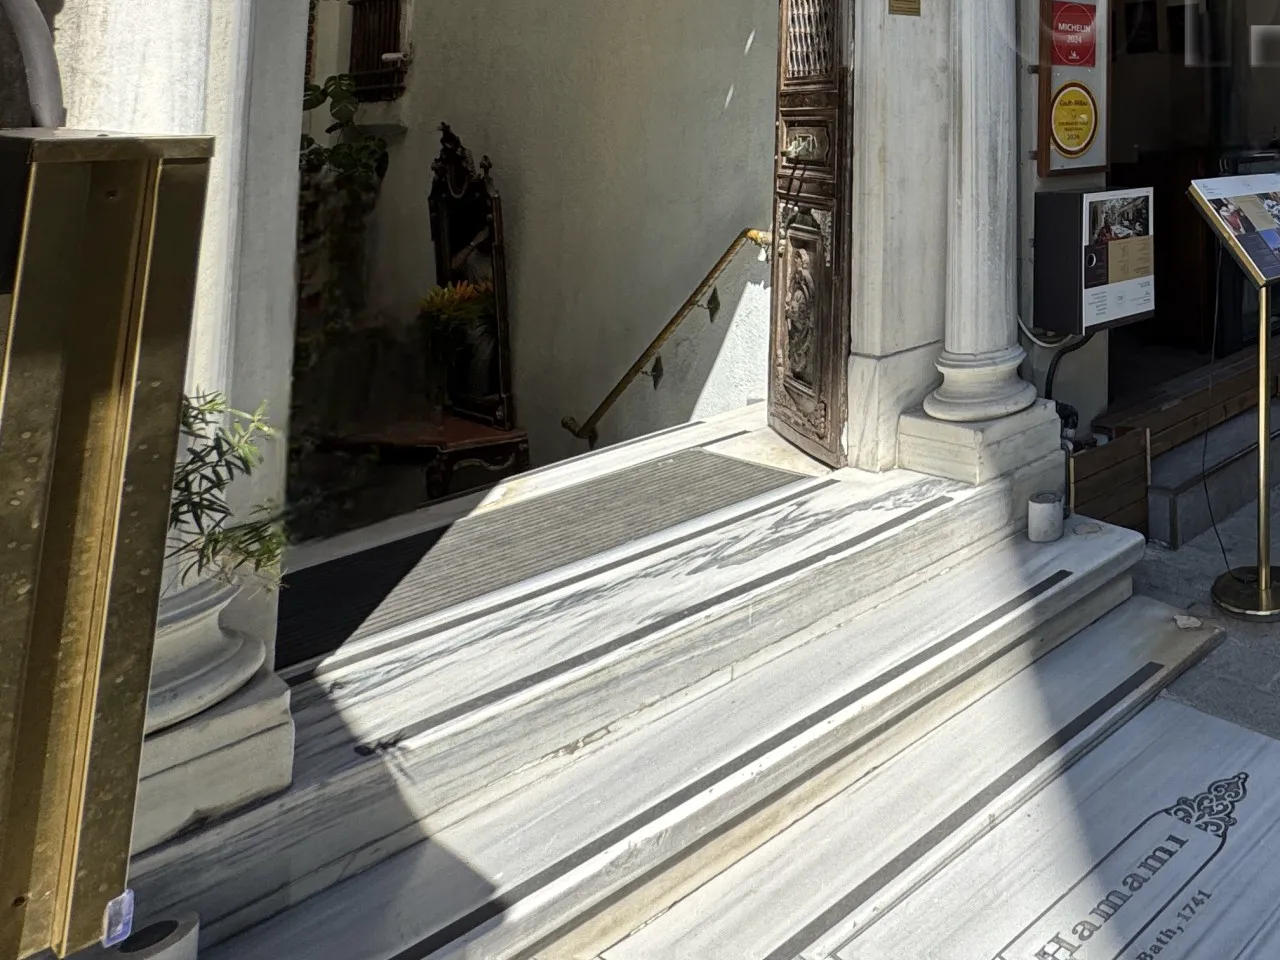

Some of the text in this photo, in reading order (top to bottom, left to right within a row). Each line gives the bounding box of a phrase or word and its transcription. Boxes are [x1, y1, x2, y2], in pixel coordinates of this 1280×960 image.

[1058, 22, 1091, 33] MICHELIN
[1067, 34, 1082, 44] 2024
[1176, 889, 1213, 923] 1741
